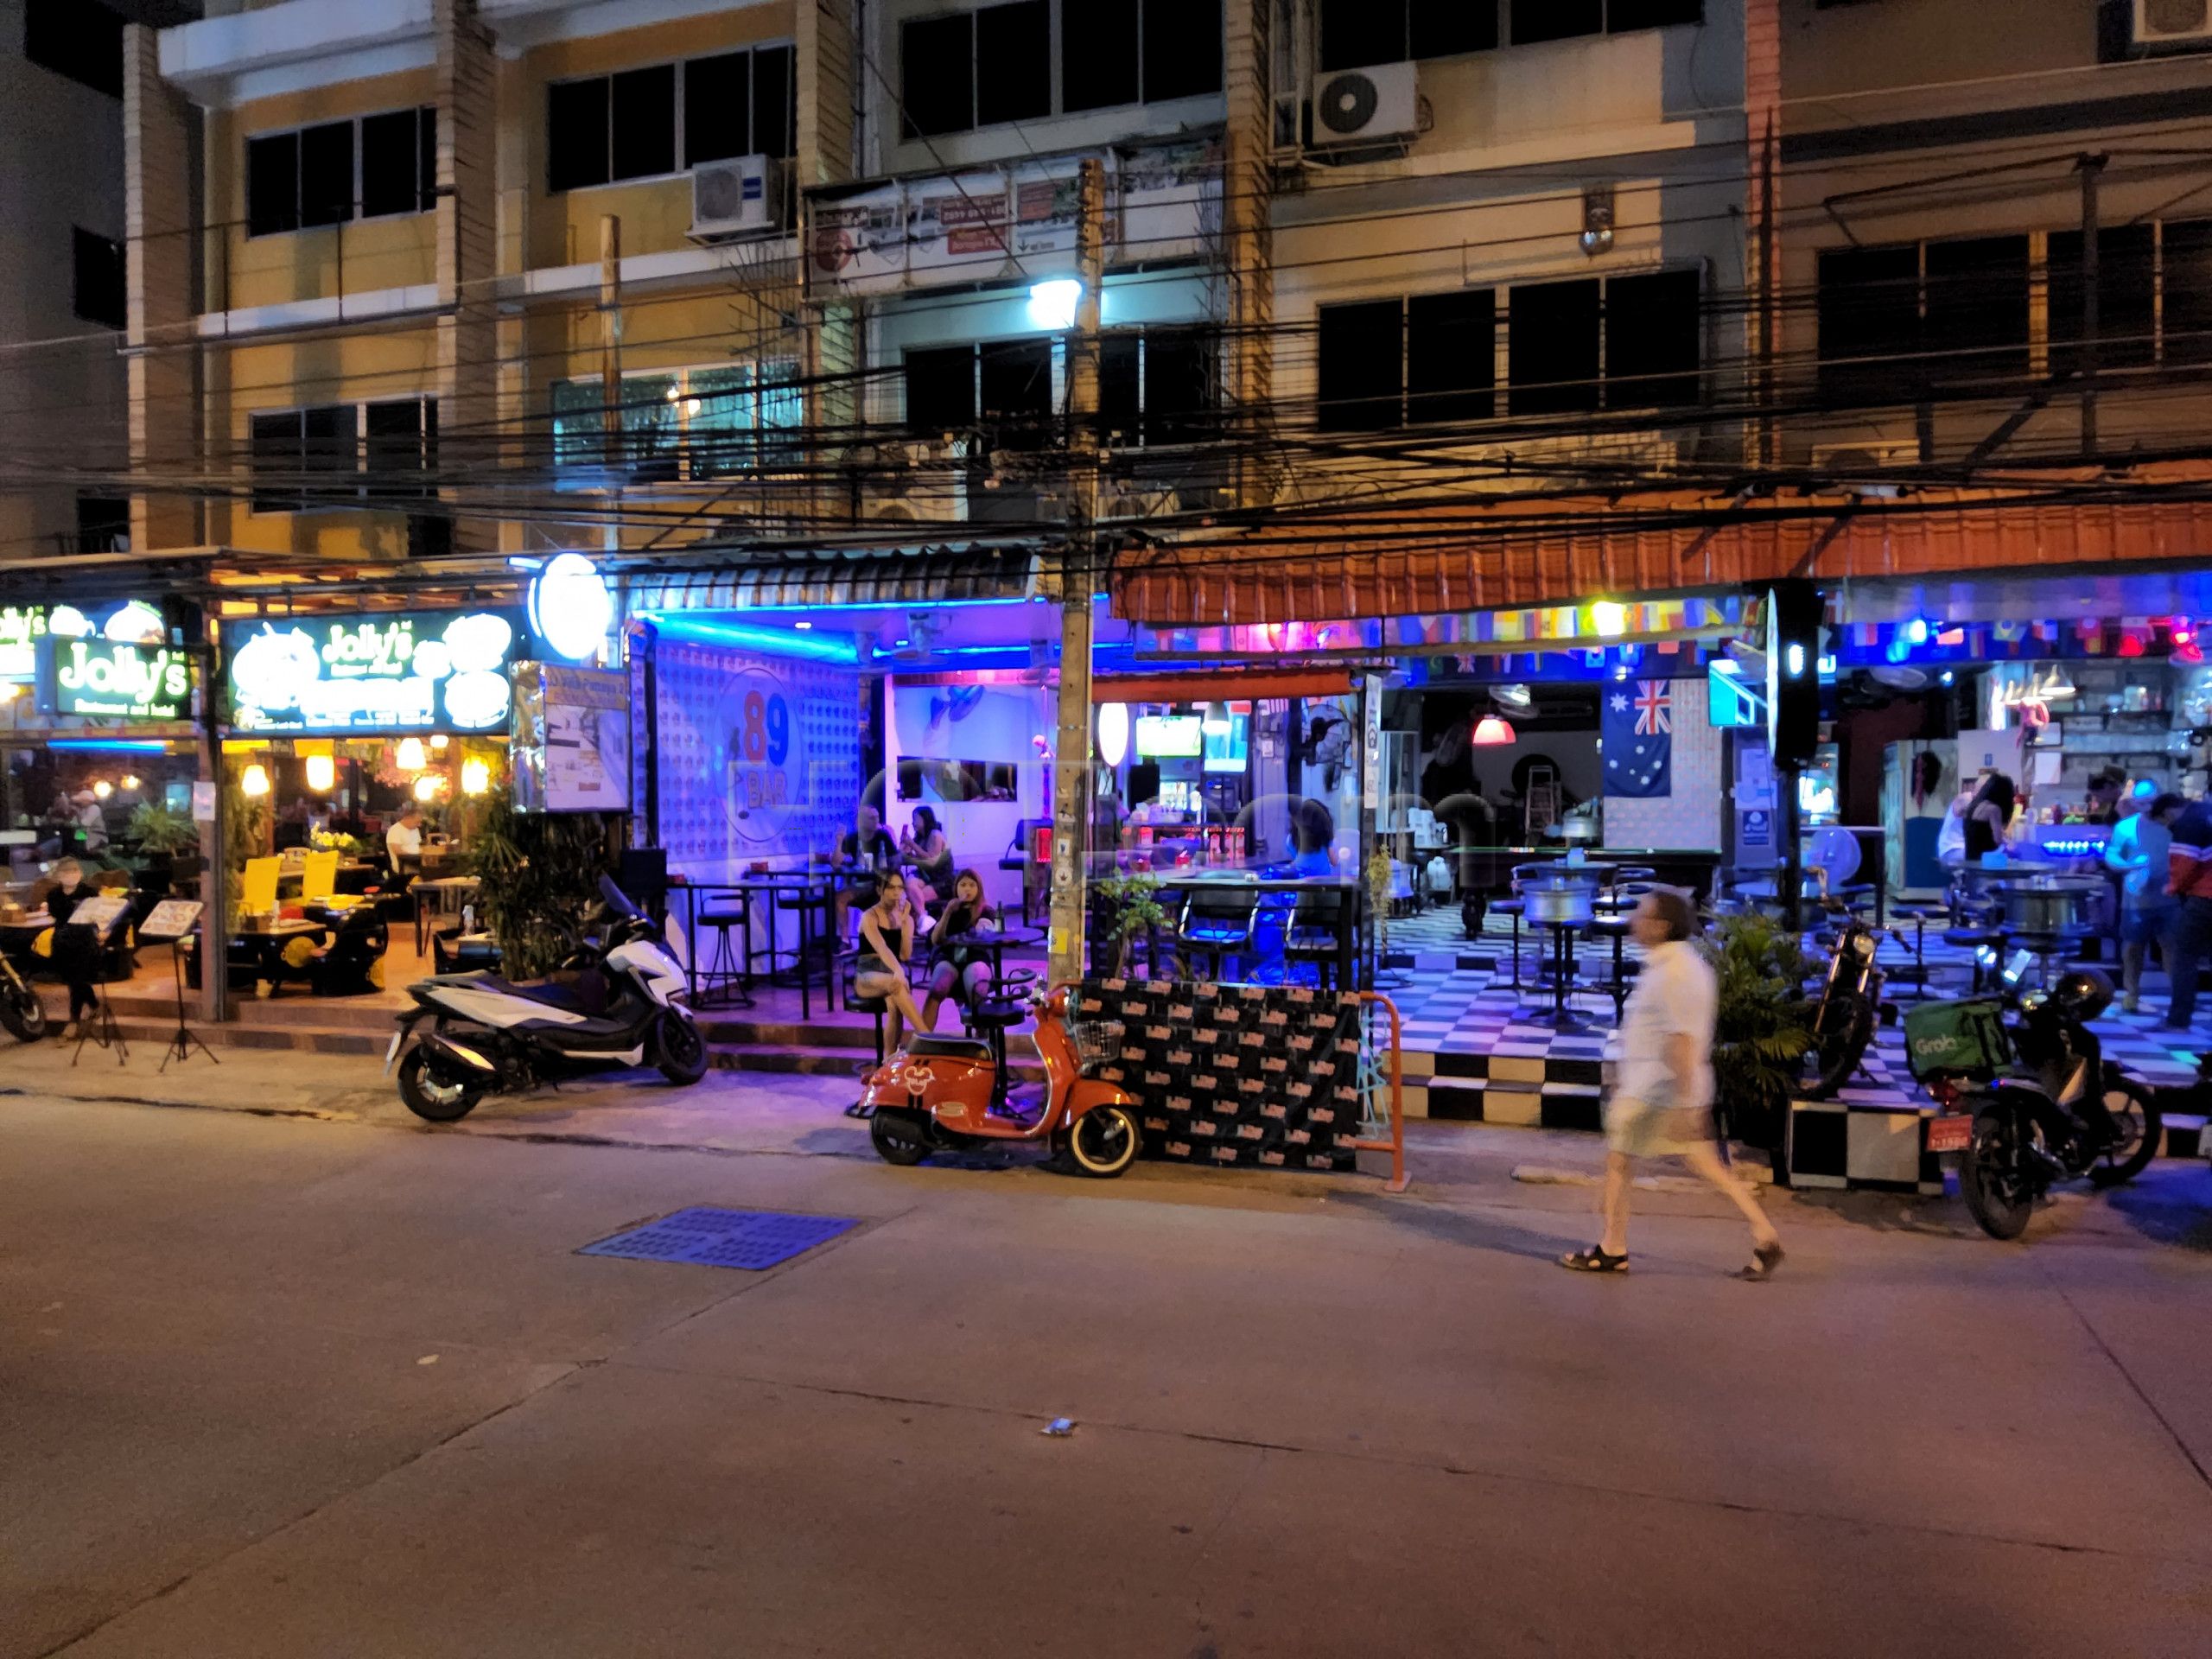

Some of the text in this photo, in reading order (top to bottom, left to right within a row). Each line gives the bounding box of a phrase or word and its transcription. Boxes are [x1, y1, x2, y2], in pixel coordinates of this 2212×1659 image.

[59, 642, 188, 704] Jolly's
[744, 690, 789, 767] 89
[747, 770, 788, 810] BAR
[1916, 1033, 1957, 1055] Grab
